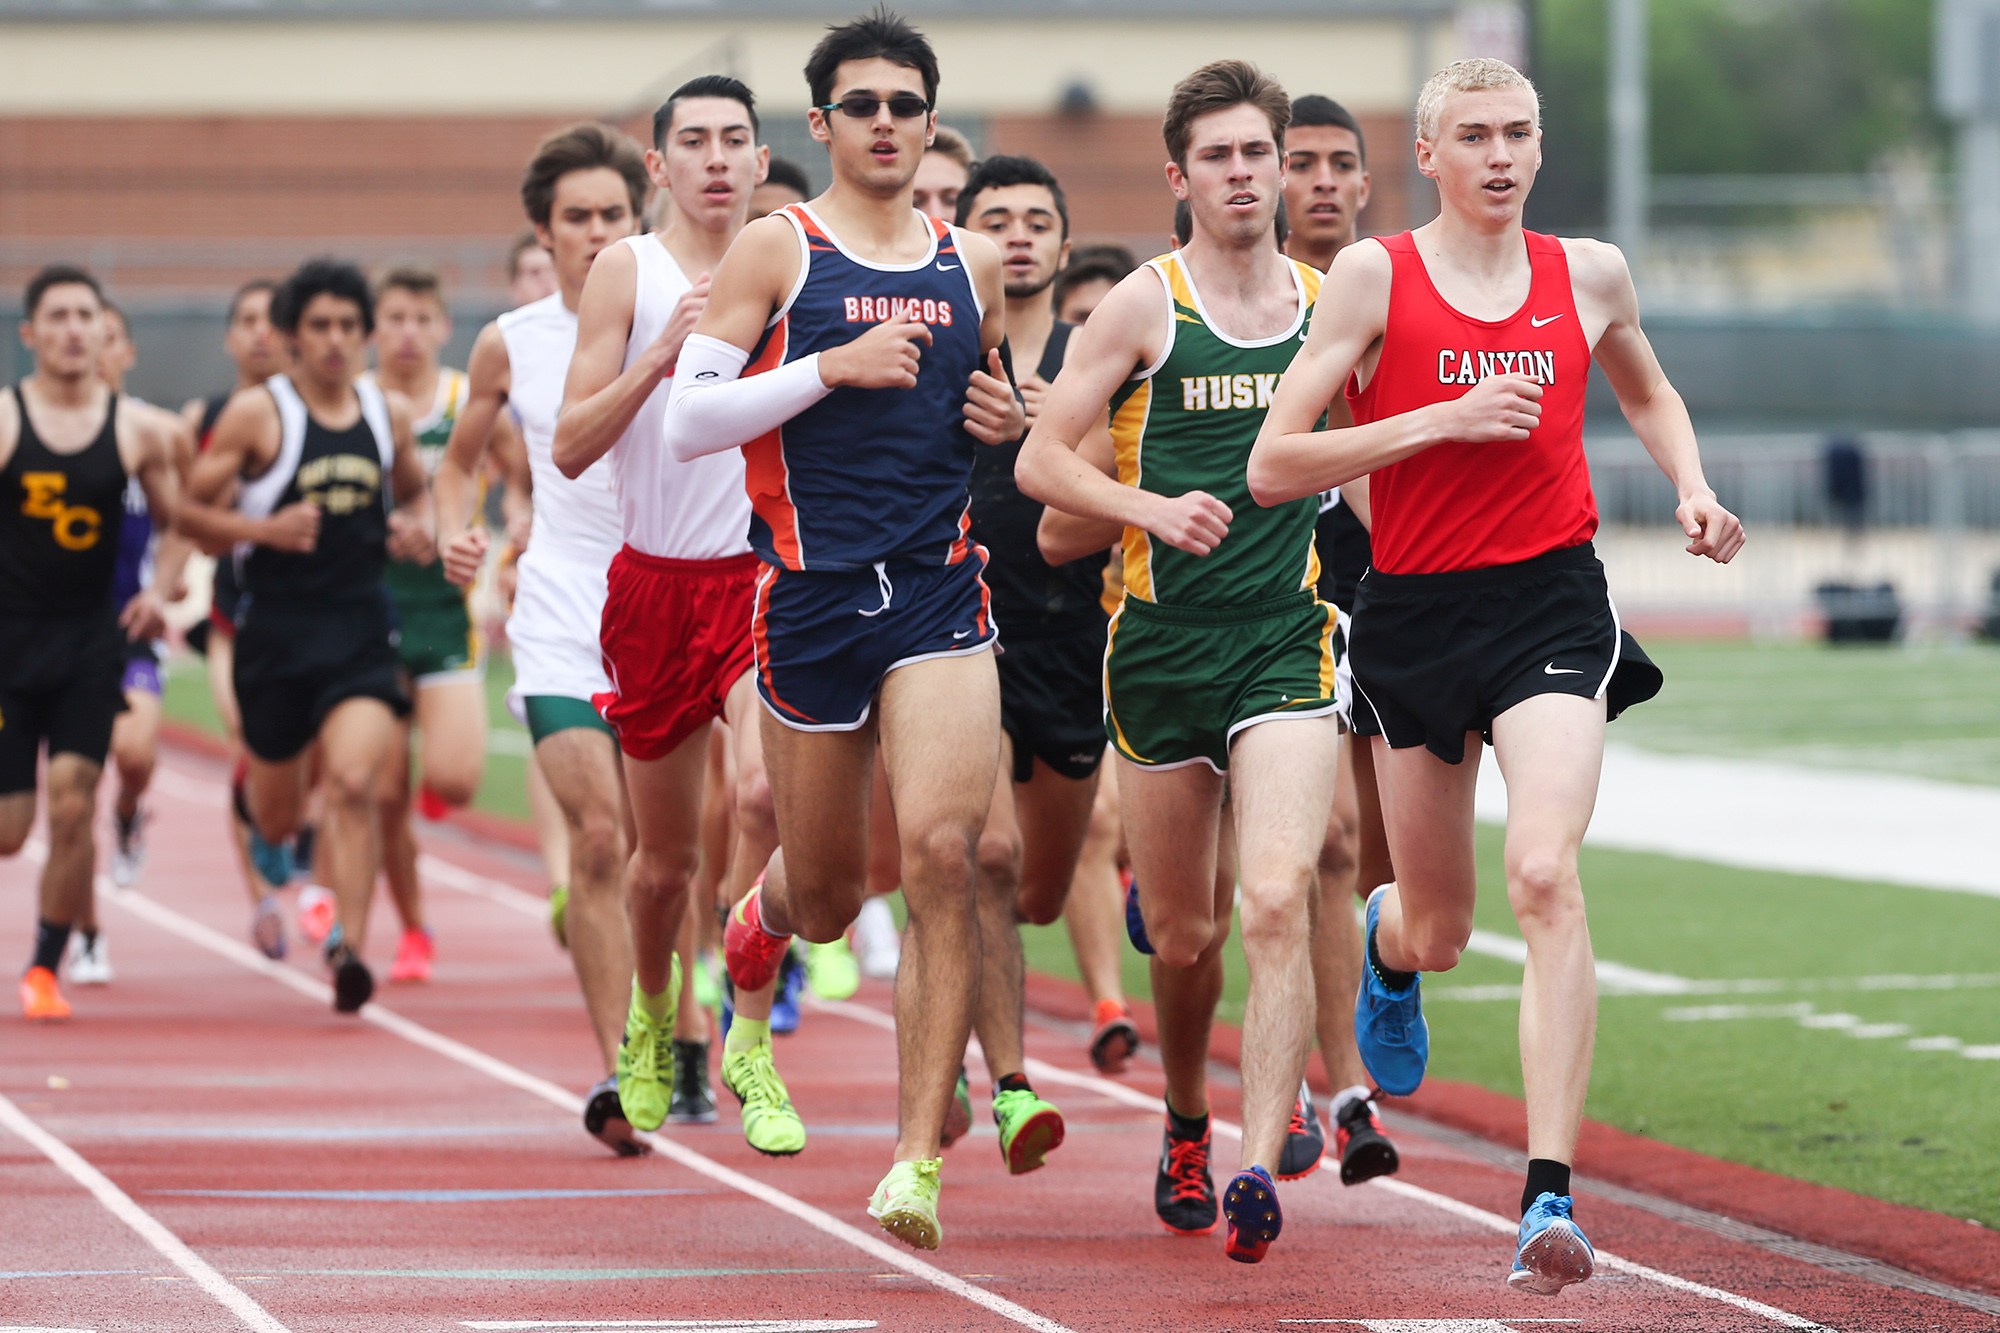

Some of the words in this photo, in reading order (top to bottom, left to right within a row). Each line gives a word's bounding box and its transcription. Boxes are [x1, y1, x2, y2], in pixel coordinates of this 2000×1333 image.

[844, 296, 953, 327] BRONCOS
[1438, 349, 1555, 386] CANYON
[1180, 373, 1284, 411] HUSK
